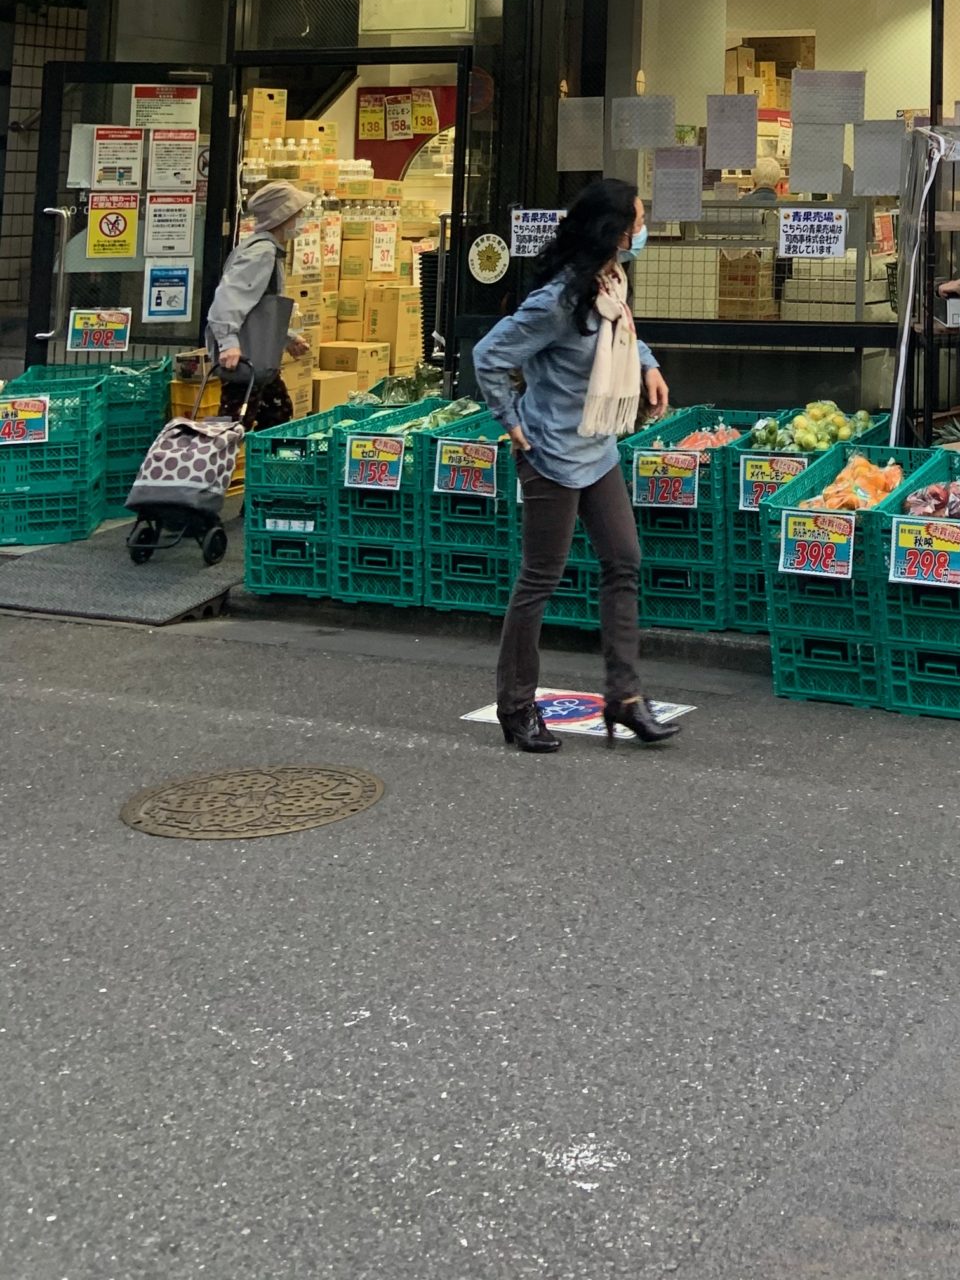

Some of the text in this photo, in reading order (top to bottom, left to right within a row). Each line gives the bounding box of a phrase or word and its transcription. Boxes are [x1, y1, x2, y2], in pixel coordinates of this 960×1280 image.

[522, 212, 558, 223] 青果売場
[792, 211, 834, 222] 青果売場
[782, 224, 843, 234] こちらの青果売場は
